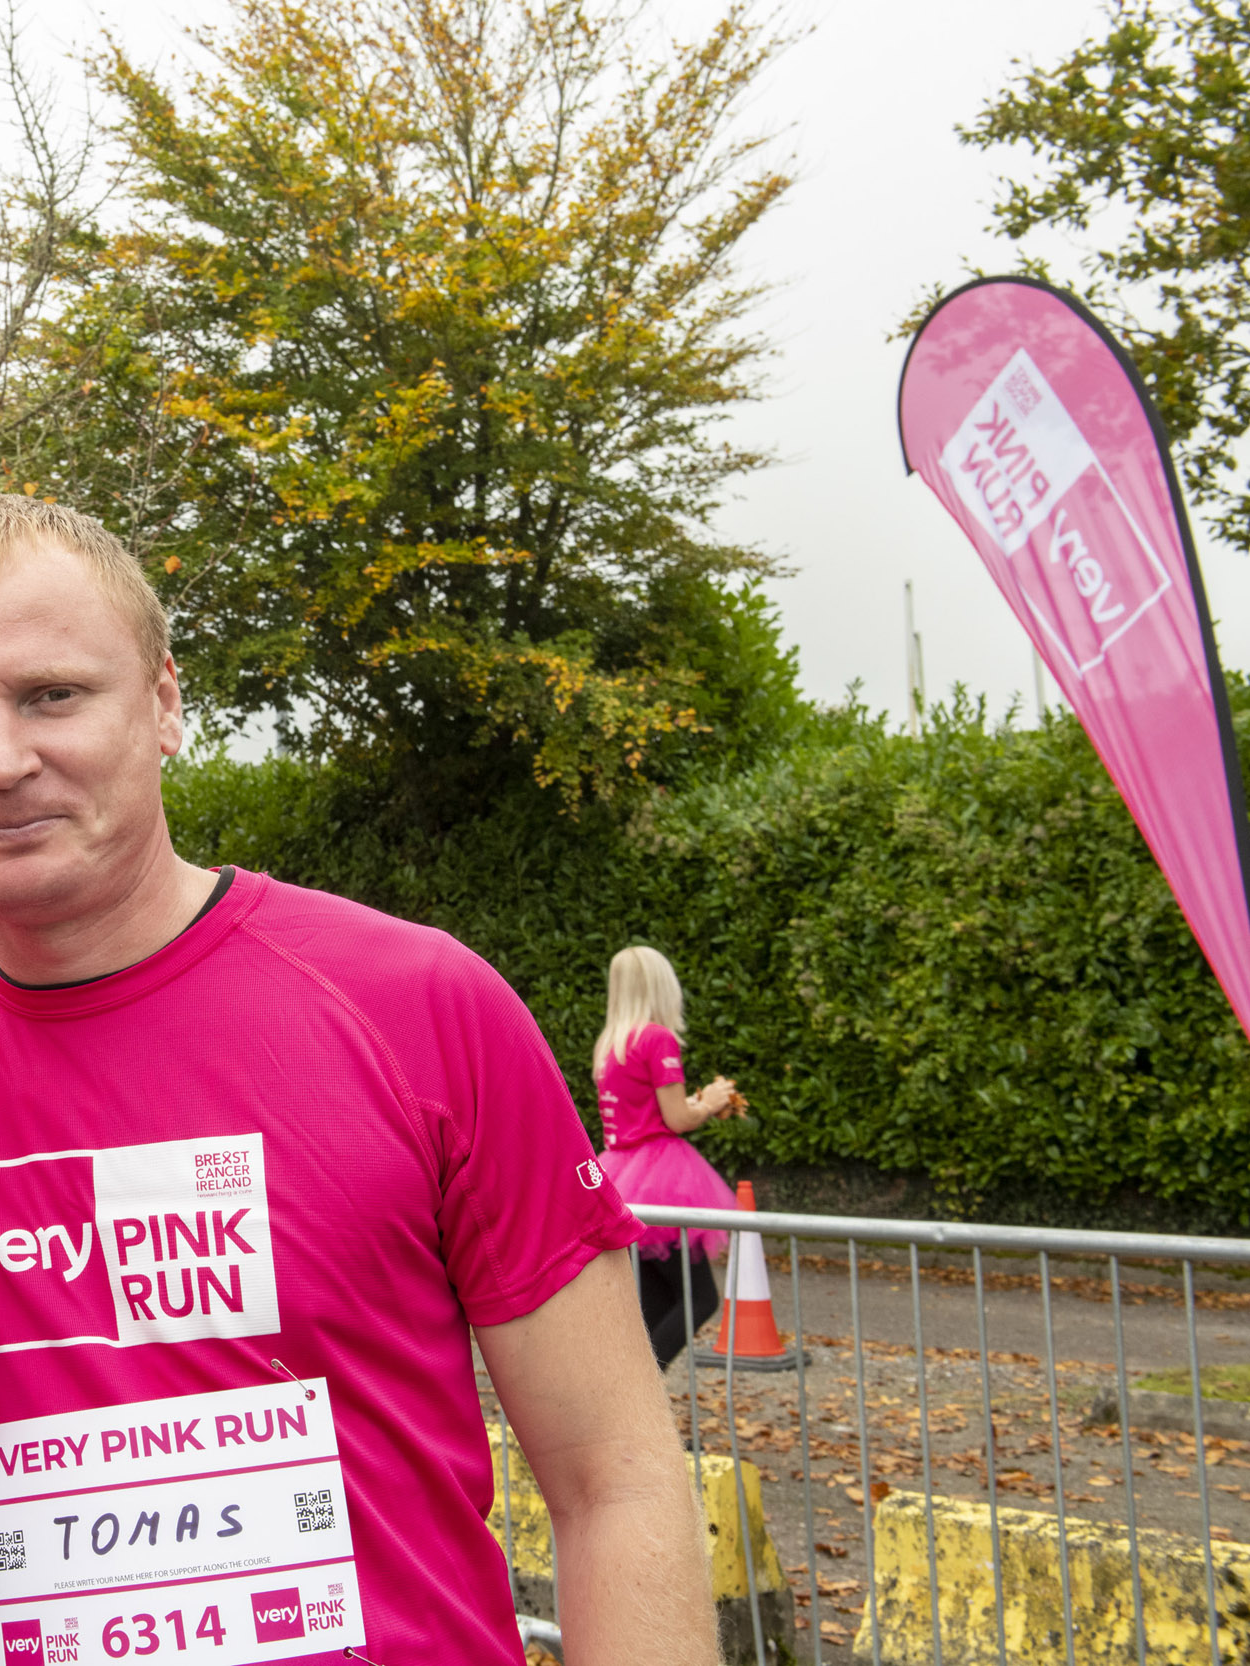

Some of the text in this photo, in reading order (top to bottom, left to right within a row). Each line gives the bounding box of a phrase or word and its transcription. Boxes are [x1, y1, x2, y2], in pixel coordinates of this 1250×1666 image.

[196, 1164, 250, 1179] CANCER
[196, 1177, 251, 1191] IRELAND
[113, 1208, 257, 1266] PINK
[120, 1264, 244, 1320] RUN
[100, 1418, 206, 1462] PINK
[214, 1404, 308, 1448] RUN
[54, 1503, 243, 1560] TOMAS
[54, 1556, 272, 1590] PLEASE WRITE YOUR NAME HERE FOR SUPPORT ALONG THE COURSE
[256, 1605, 298, 1624] very
[306, 1598, 346, 1616] PINK
[102, 1603, 226, 1658] 6314
[308, 1614, 344, 1632] RUN
[6, 1637, 40, 1654] very
[46, 1632, 80, 1648] PINK
[48, 1648, 78, 1664] RUN
